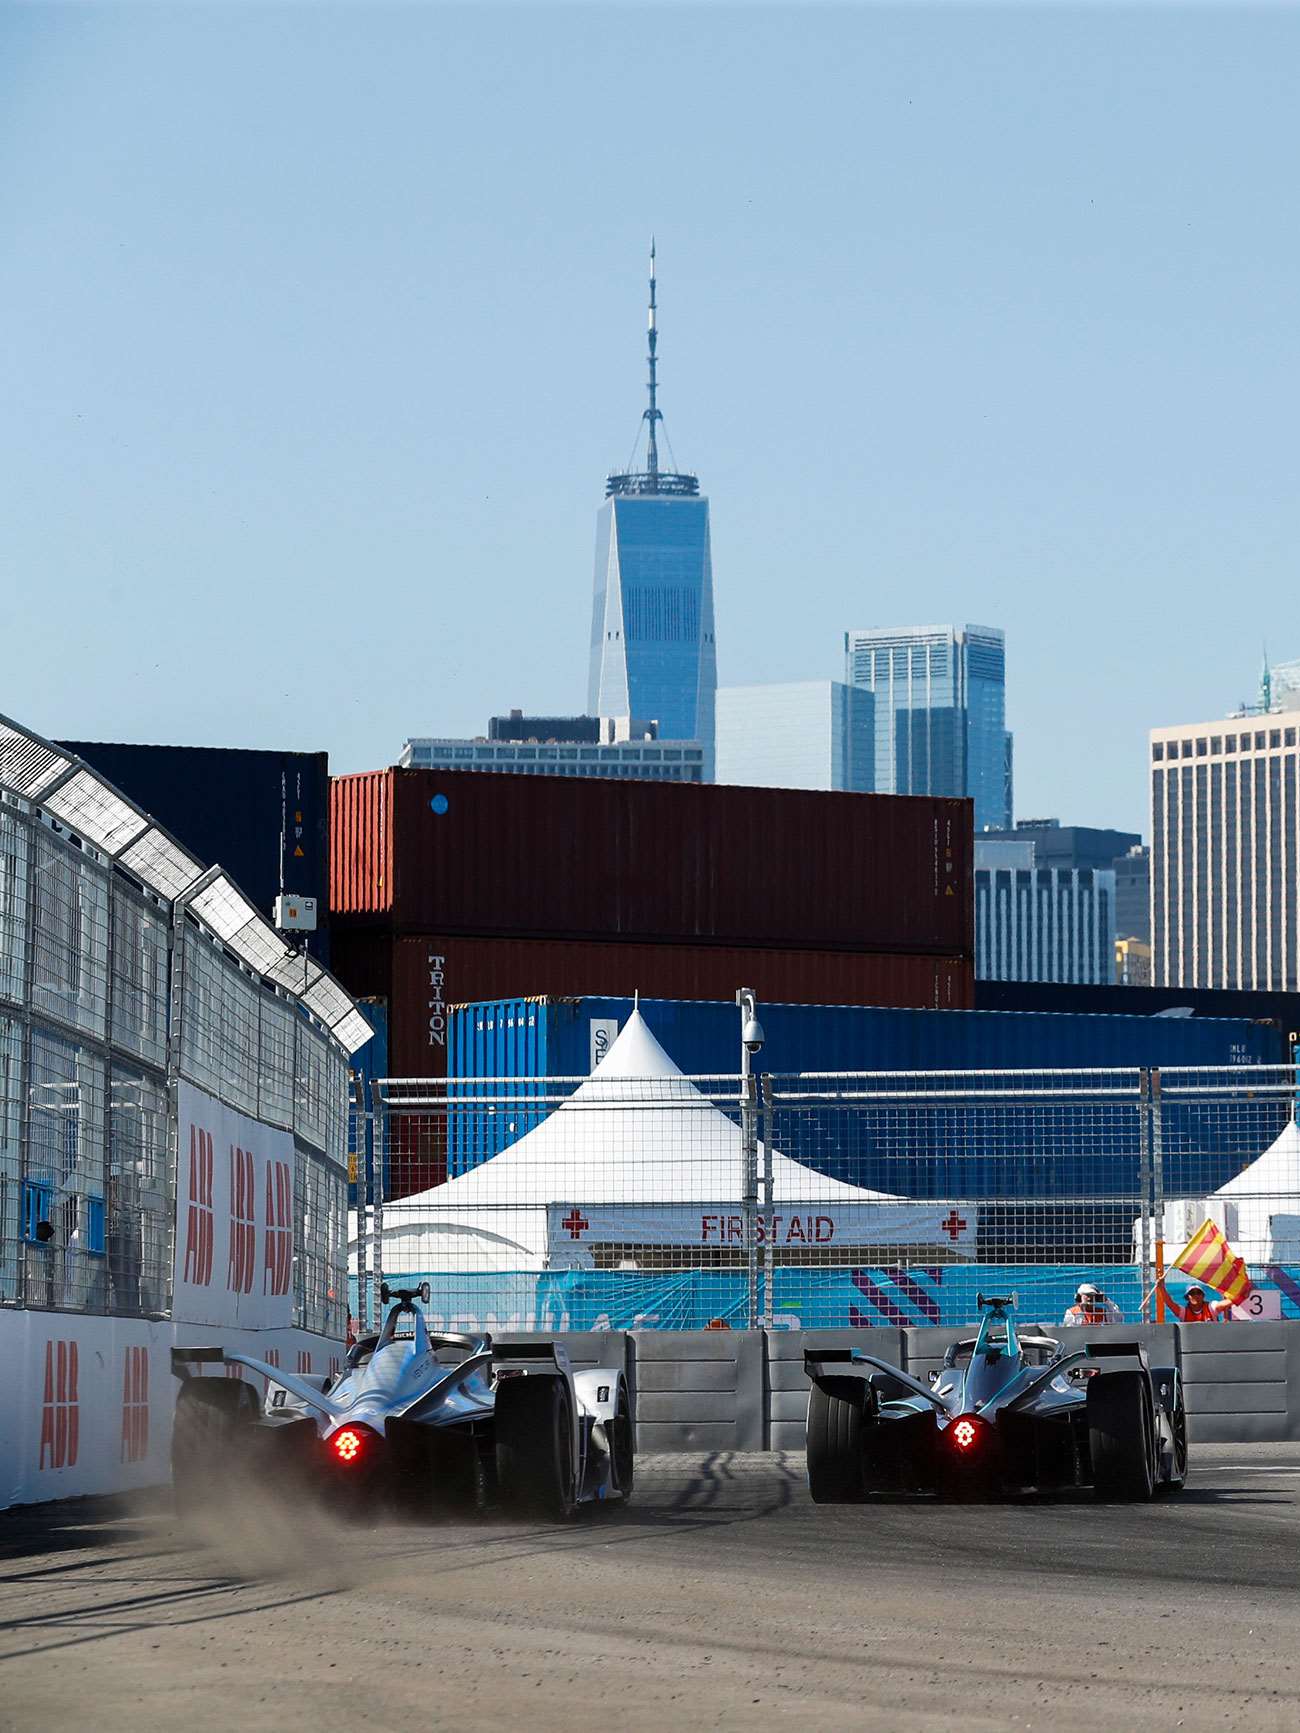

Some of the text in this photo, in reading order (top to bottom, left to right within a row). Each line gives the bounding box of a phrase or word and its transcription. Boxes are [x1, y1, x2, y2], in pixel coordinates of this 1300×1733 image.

[429, 956, 444, 1045] TRITON
[184, 1124, 213, 1286] ABB
[227, 1144, 256, 1294] ABB
[264, 1160, 292, 1296] ABB
[702, 1215, 835, 1243] FIRST AID
[1249, 1294, 1264, 1316] 3
[40, 1341, 79, 1471] ABB
[121, 1347, 148, 1464] ABB
